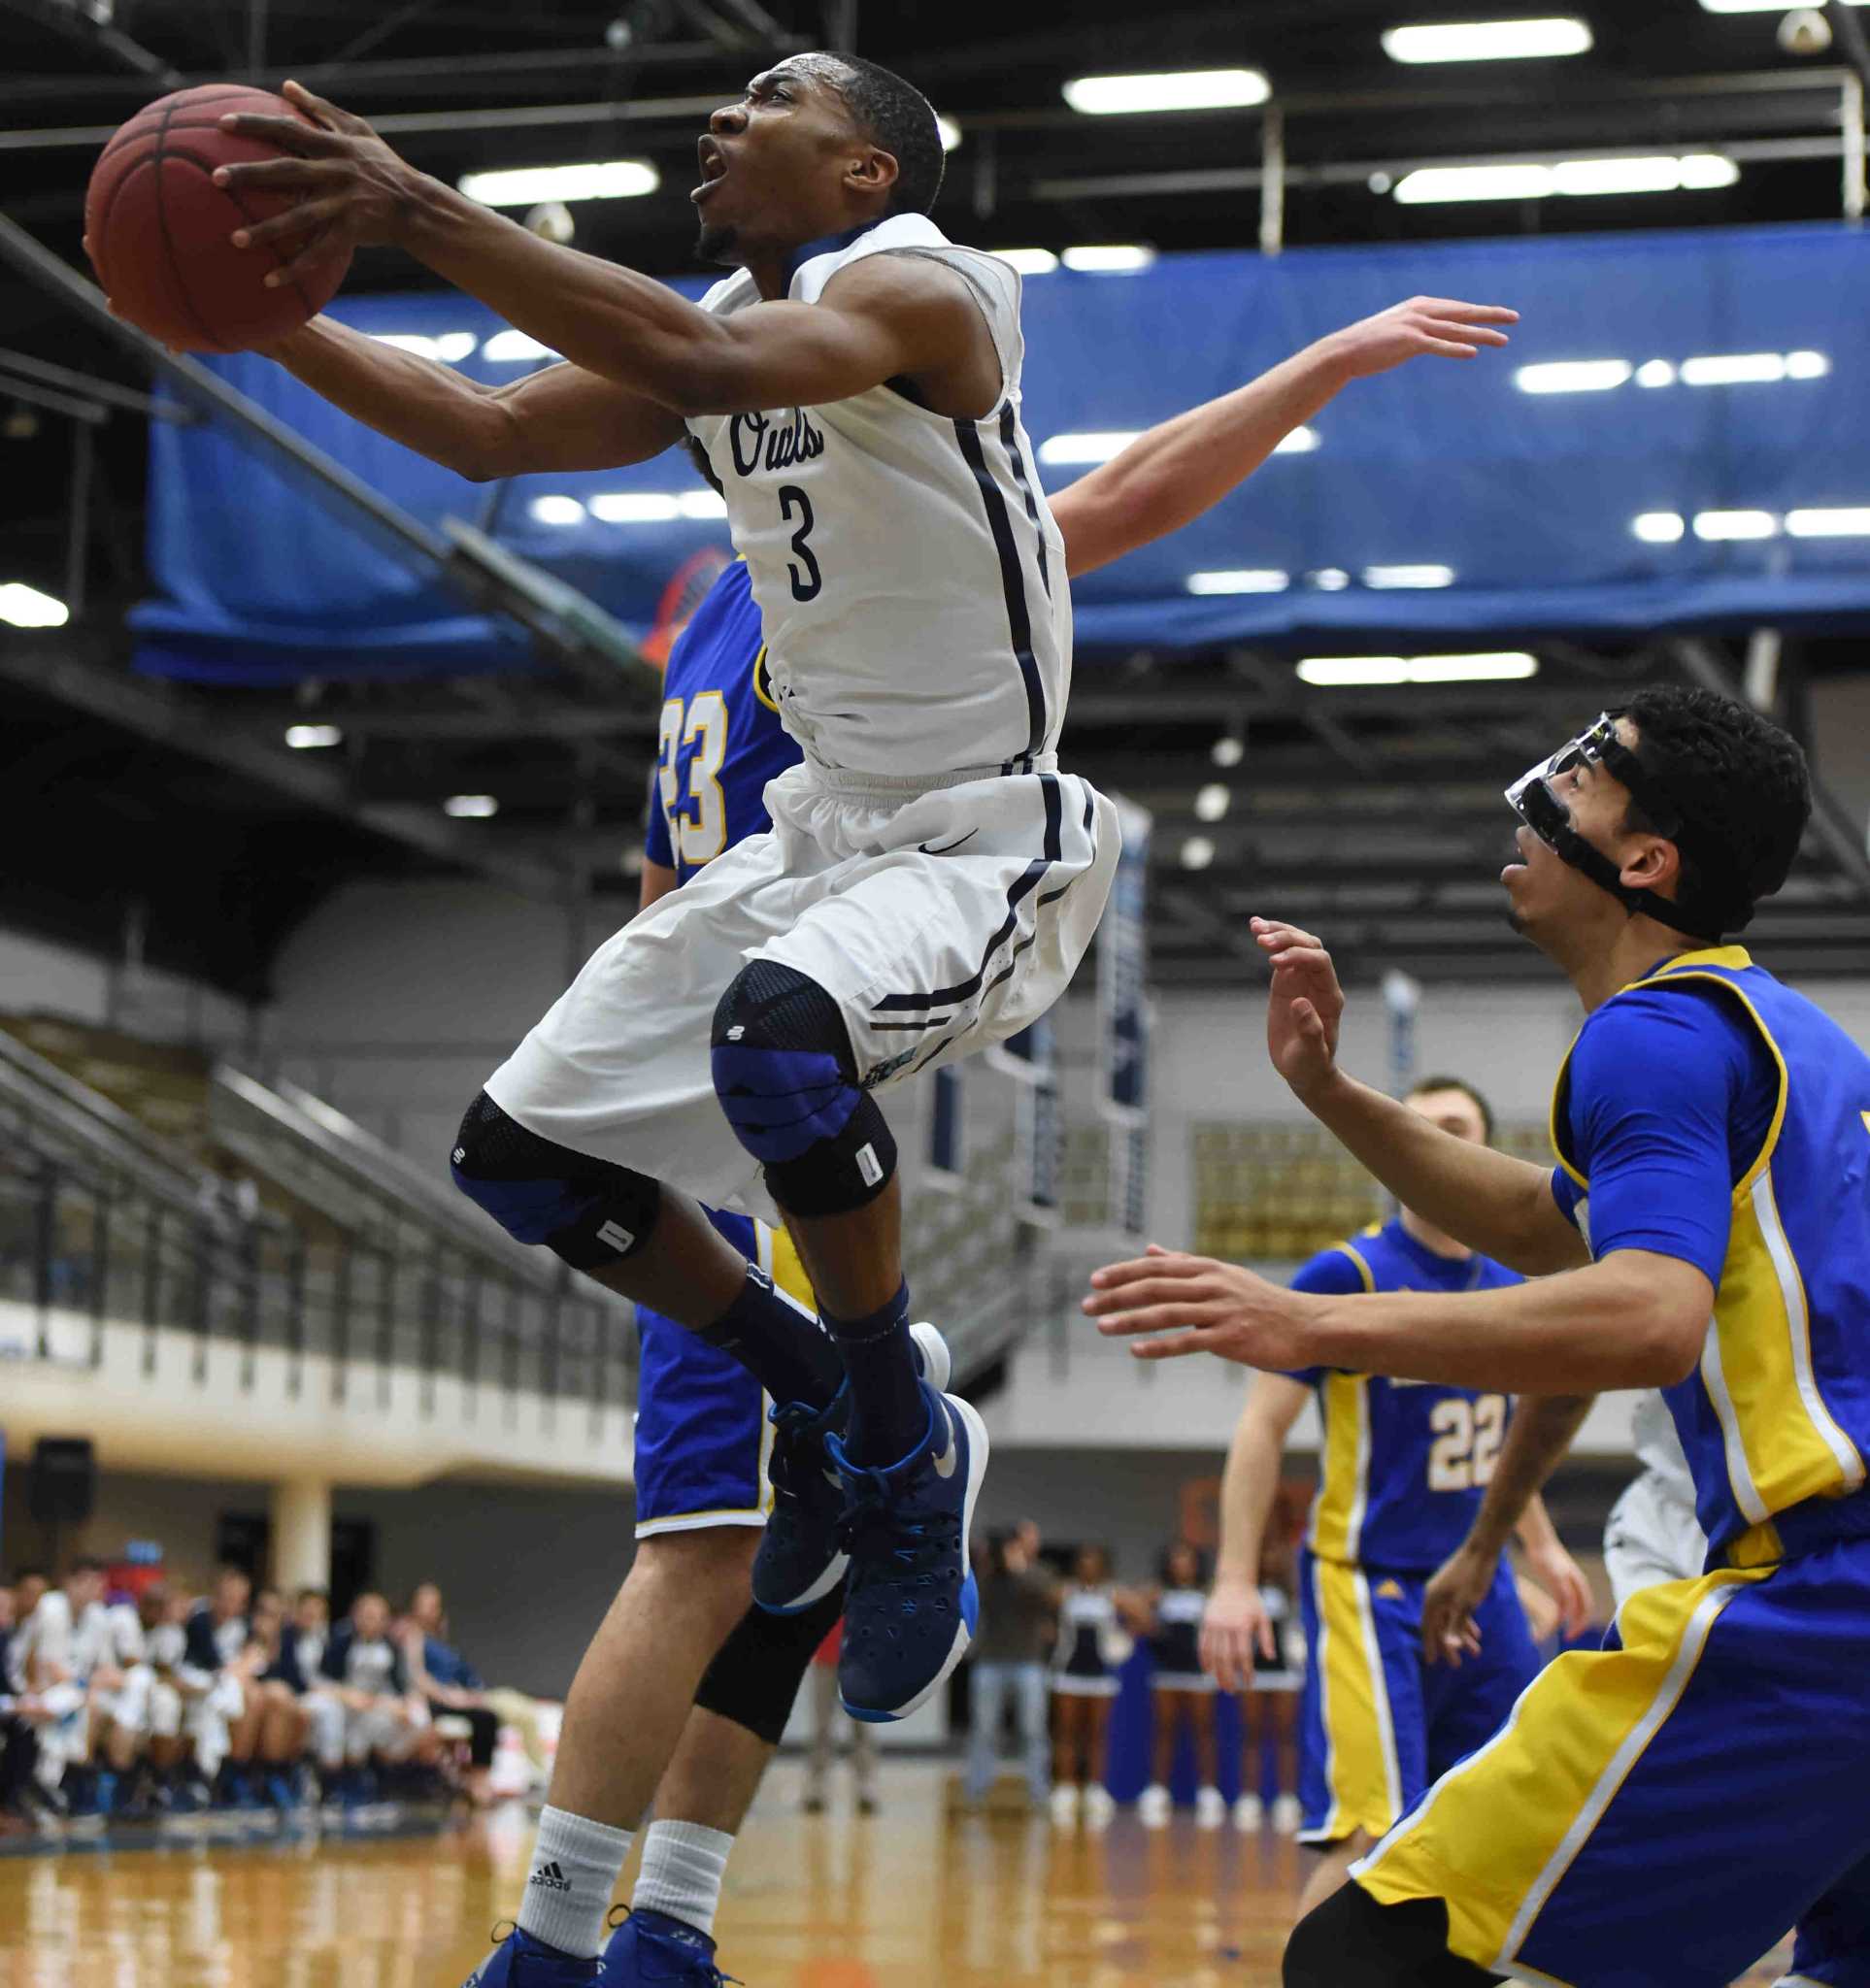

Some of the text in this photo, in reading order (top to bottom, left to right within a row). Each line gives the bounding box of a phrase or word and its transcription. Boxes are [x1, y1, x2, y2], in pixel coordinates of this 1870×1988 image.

[729, 406, 824, 477] Owls
[778, 485, 822, 602] 3
[1427, 1392, 1506, 1492] 22
